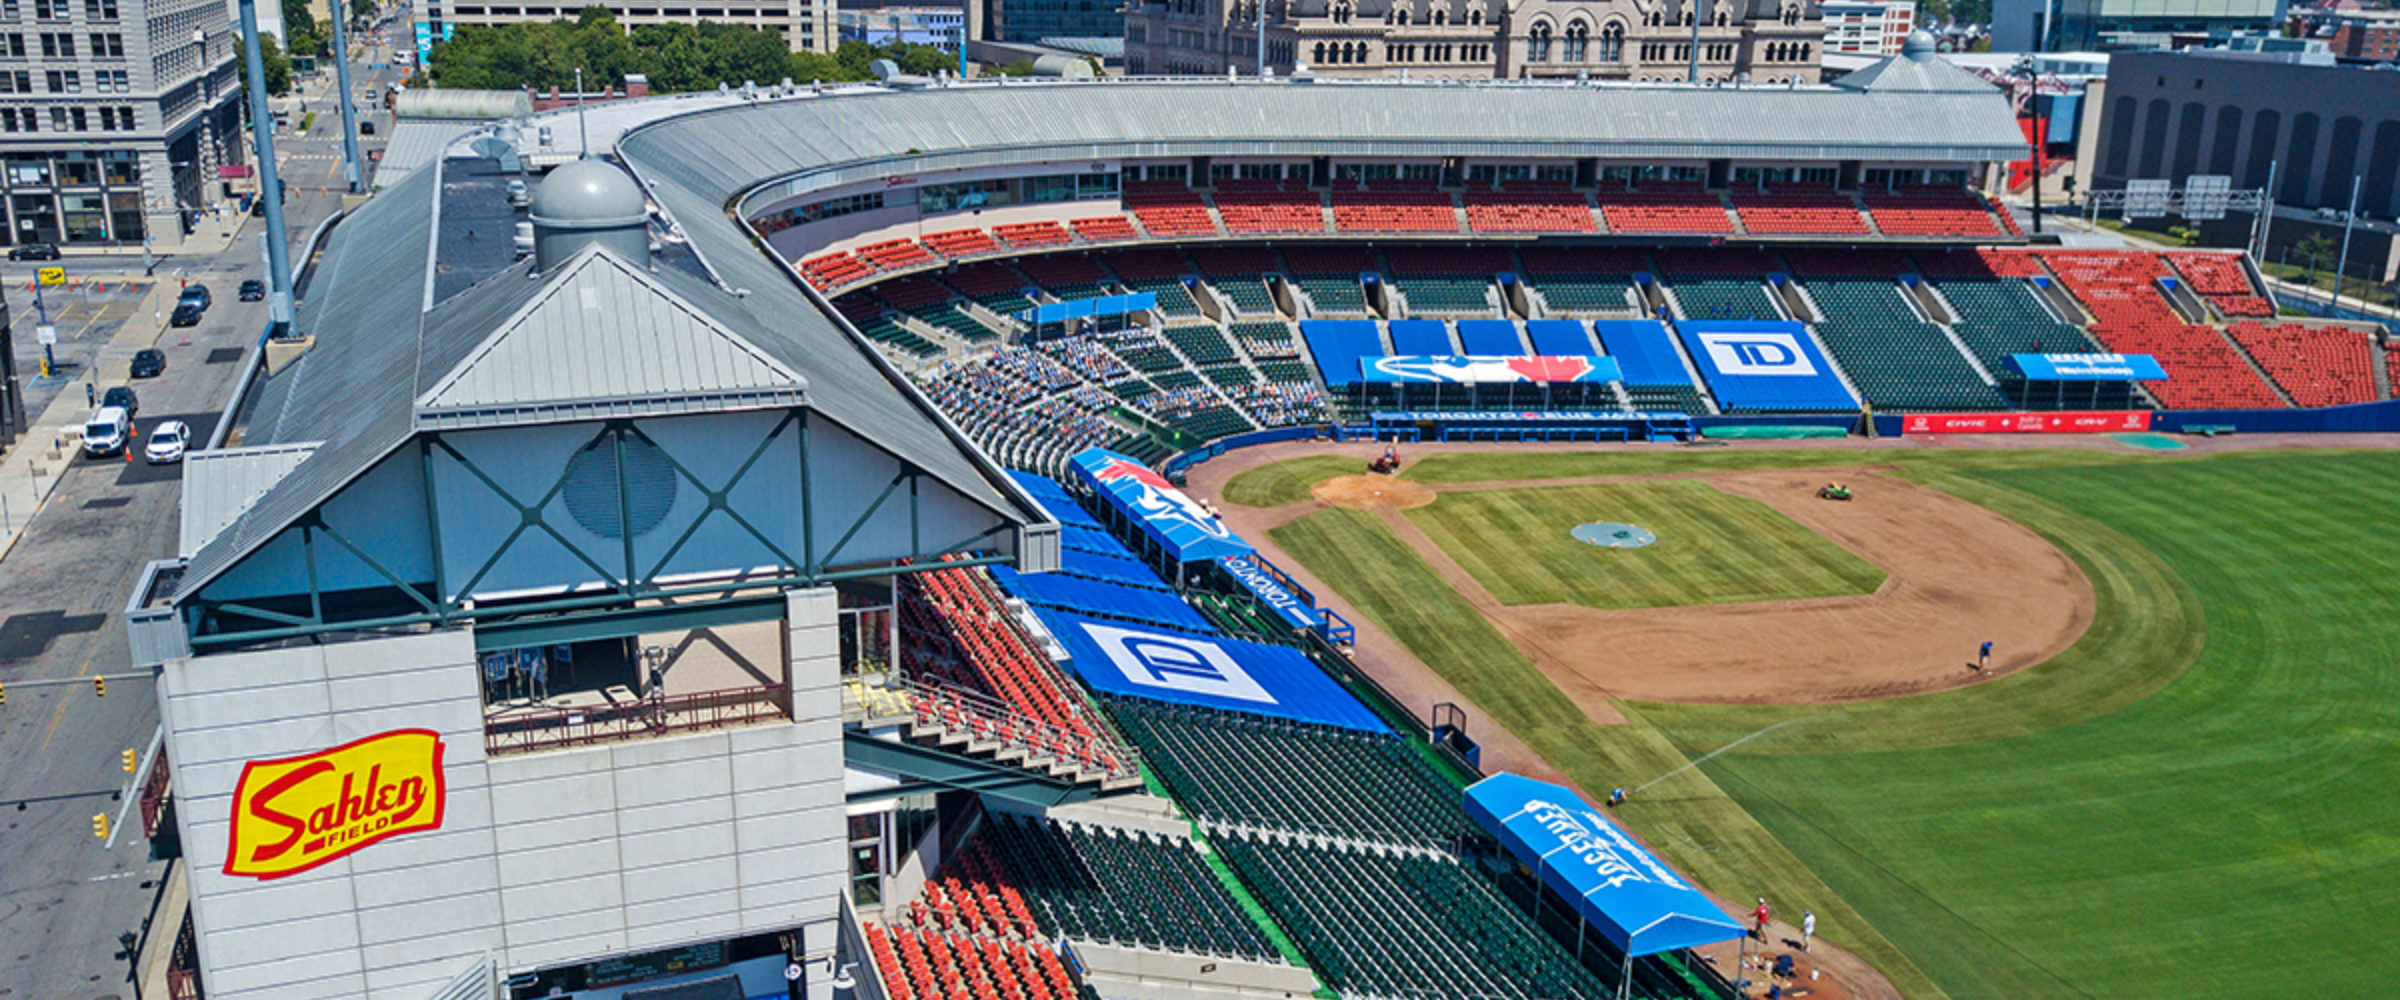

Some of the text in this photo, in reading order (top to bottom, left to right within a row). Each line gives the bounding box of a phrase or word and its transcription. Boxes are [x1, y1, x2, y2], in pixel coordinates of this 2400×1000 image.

[1713, 341, 1797, 366] TD
[1408, 411, 1517, 420] TORONTO
[1543, 411, 1598, 420] BLUE
[1946, 418, 1987, 427] CIVIC
[1225, 559, 1297, 609] TORONTO
[1121, 637, 1228, 682] TD
[250, 760, 428, 862] Sahlen
[327, 816, 389, 847] FIELD
[1523, 799, 1644, 888] TOGETHER
